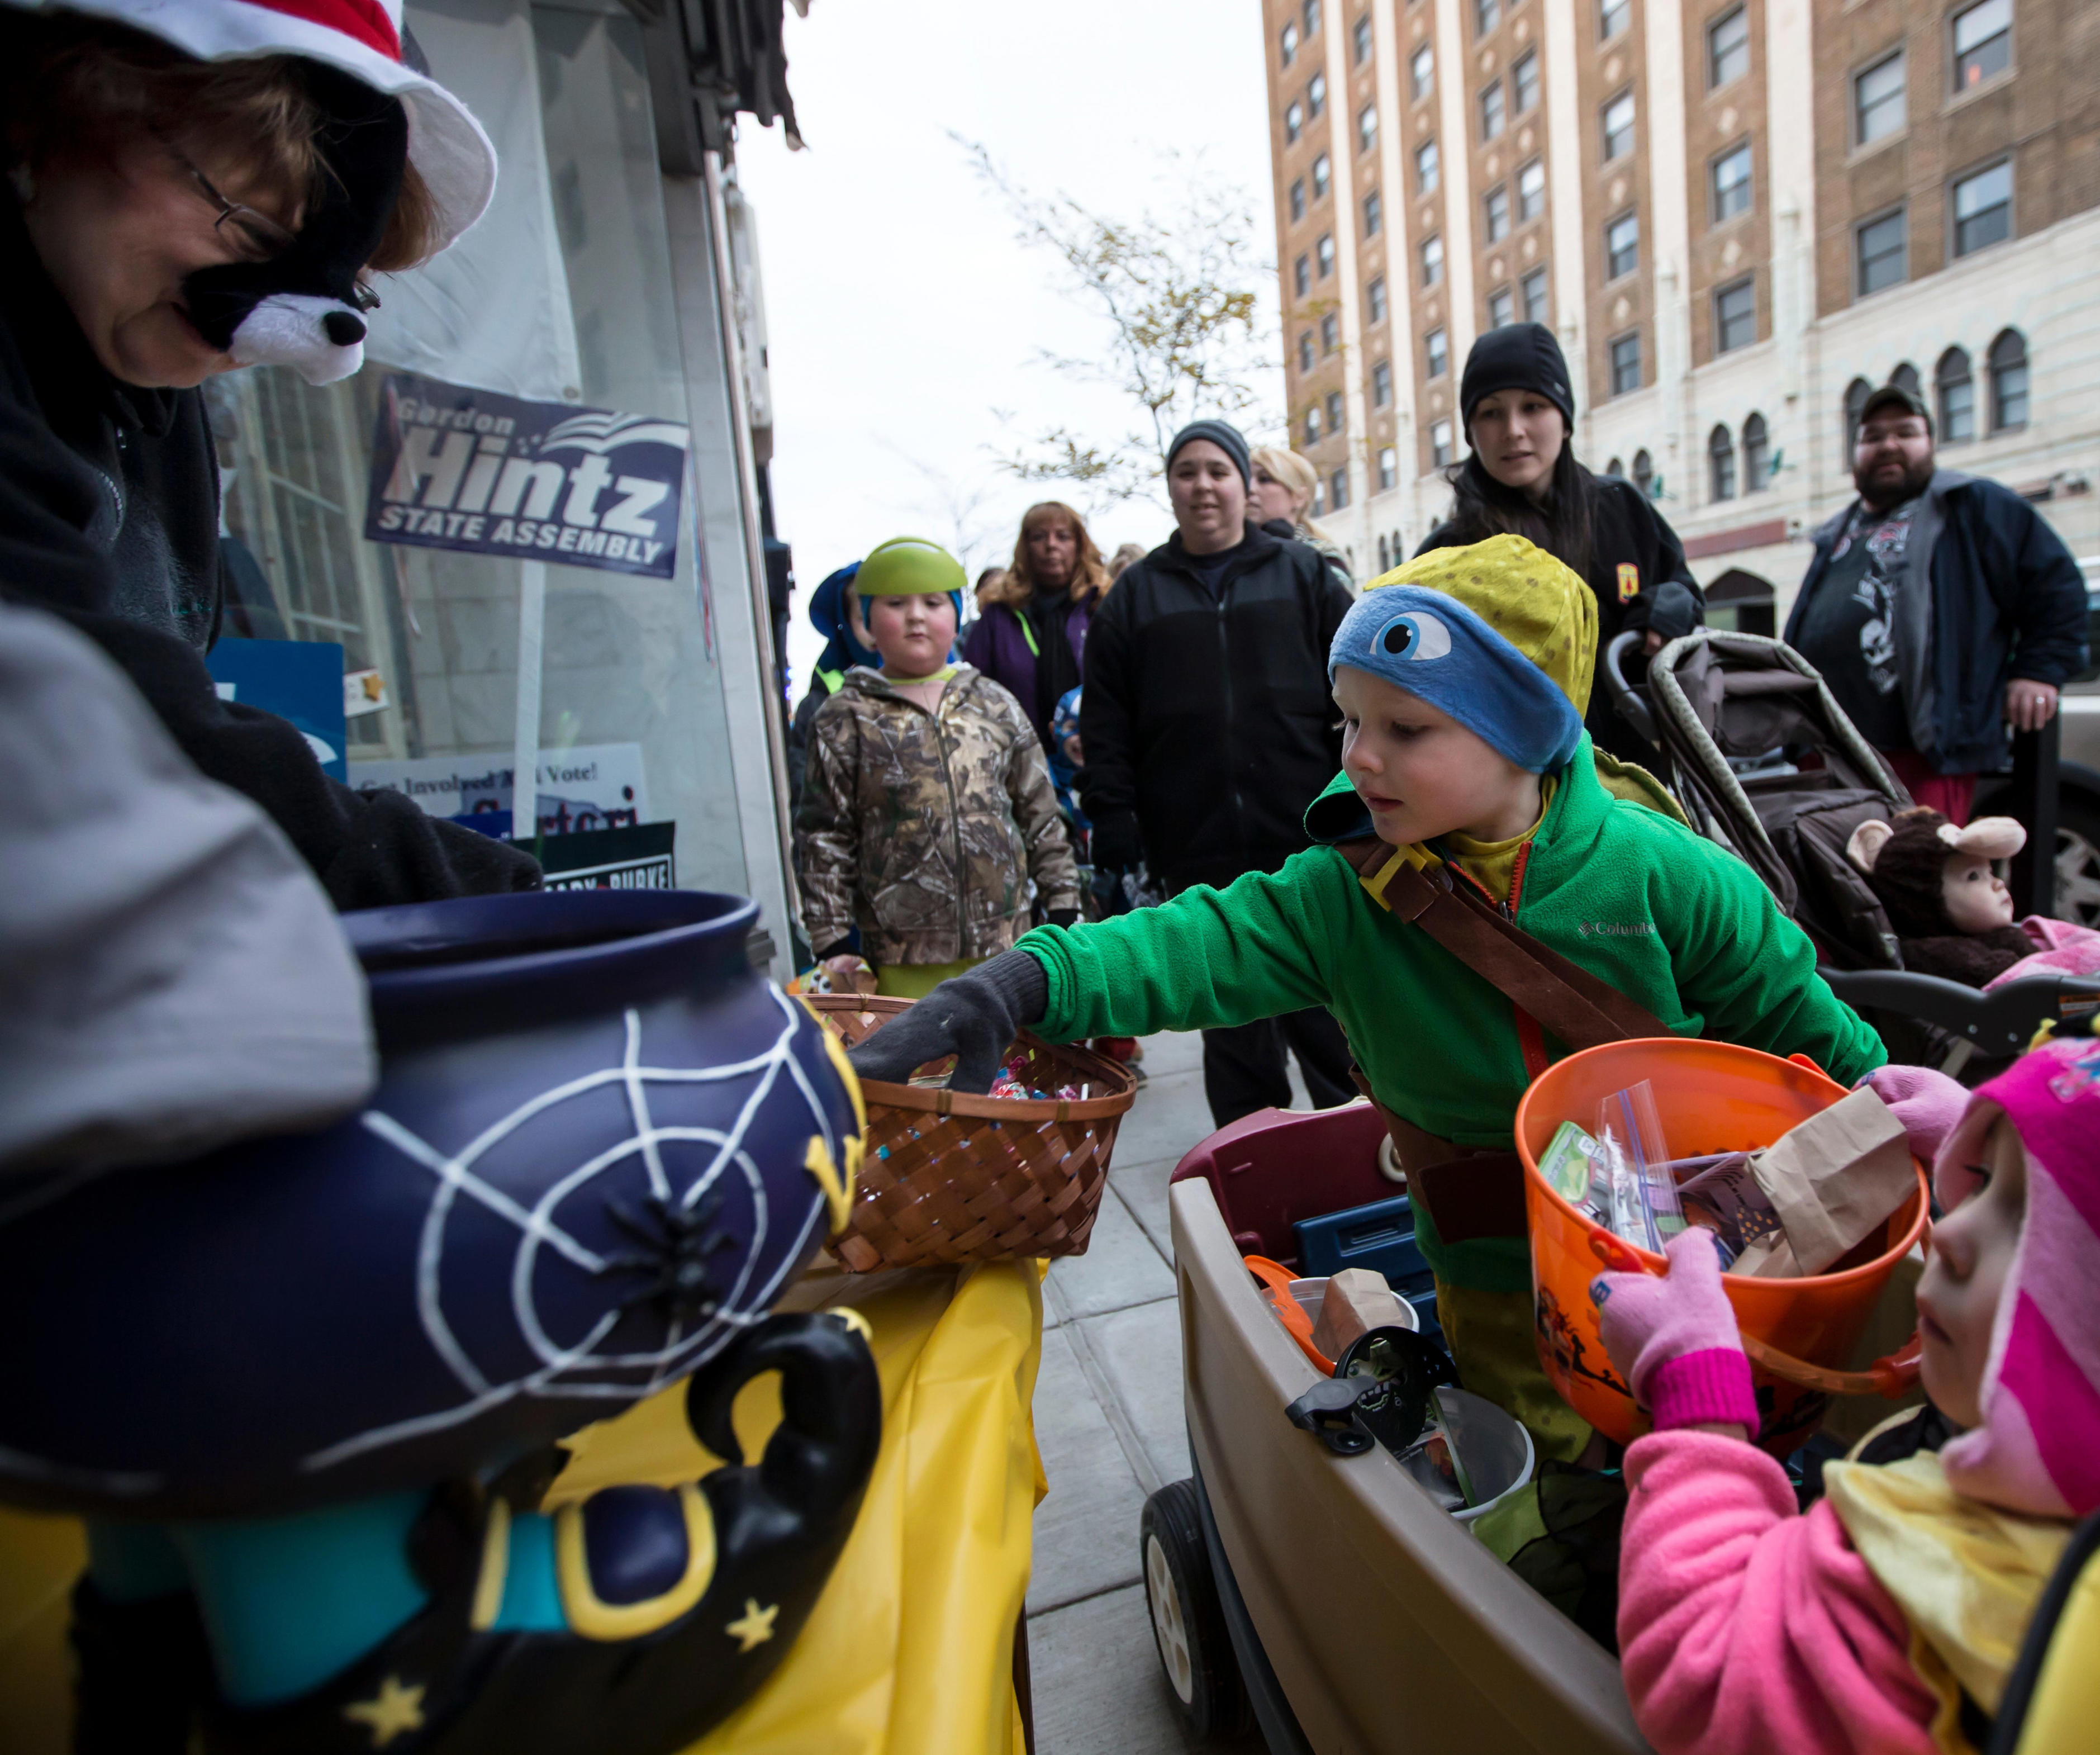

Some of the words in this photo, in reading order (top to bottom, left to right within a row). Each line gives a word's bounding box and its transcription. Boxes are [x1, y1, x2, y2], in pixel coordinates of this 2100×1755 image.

[397, 396, 515, 437] Gordon
[382, 425, 669, 538] Hintz
[377, 506, 486, 541] STATE
[490, 520, 664, 566] ASSEMBLY
[405, 769, 496, 796] Involved
[1595, 921, 1657, 936] Columb
